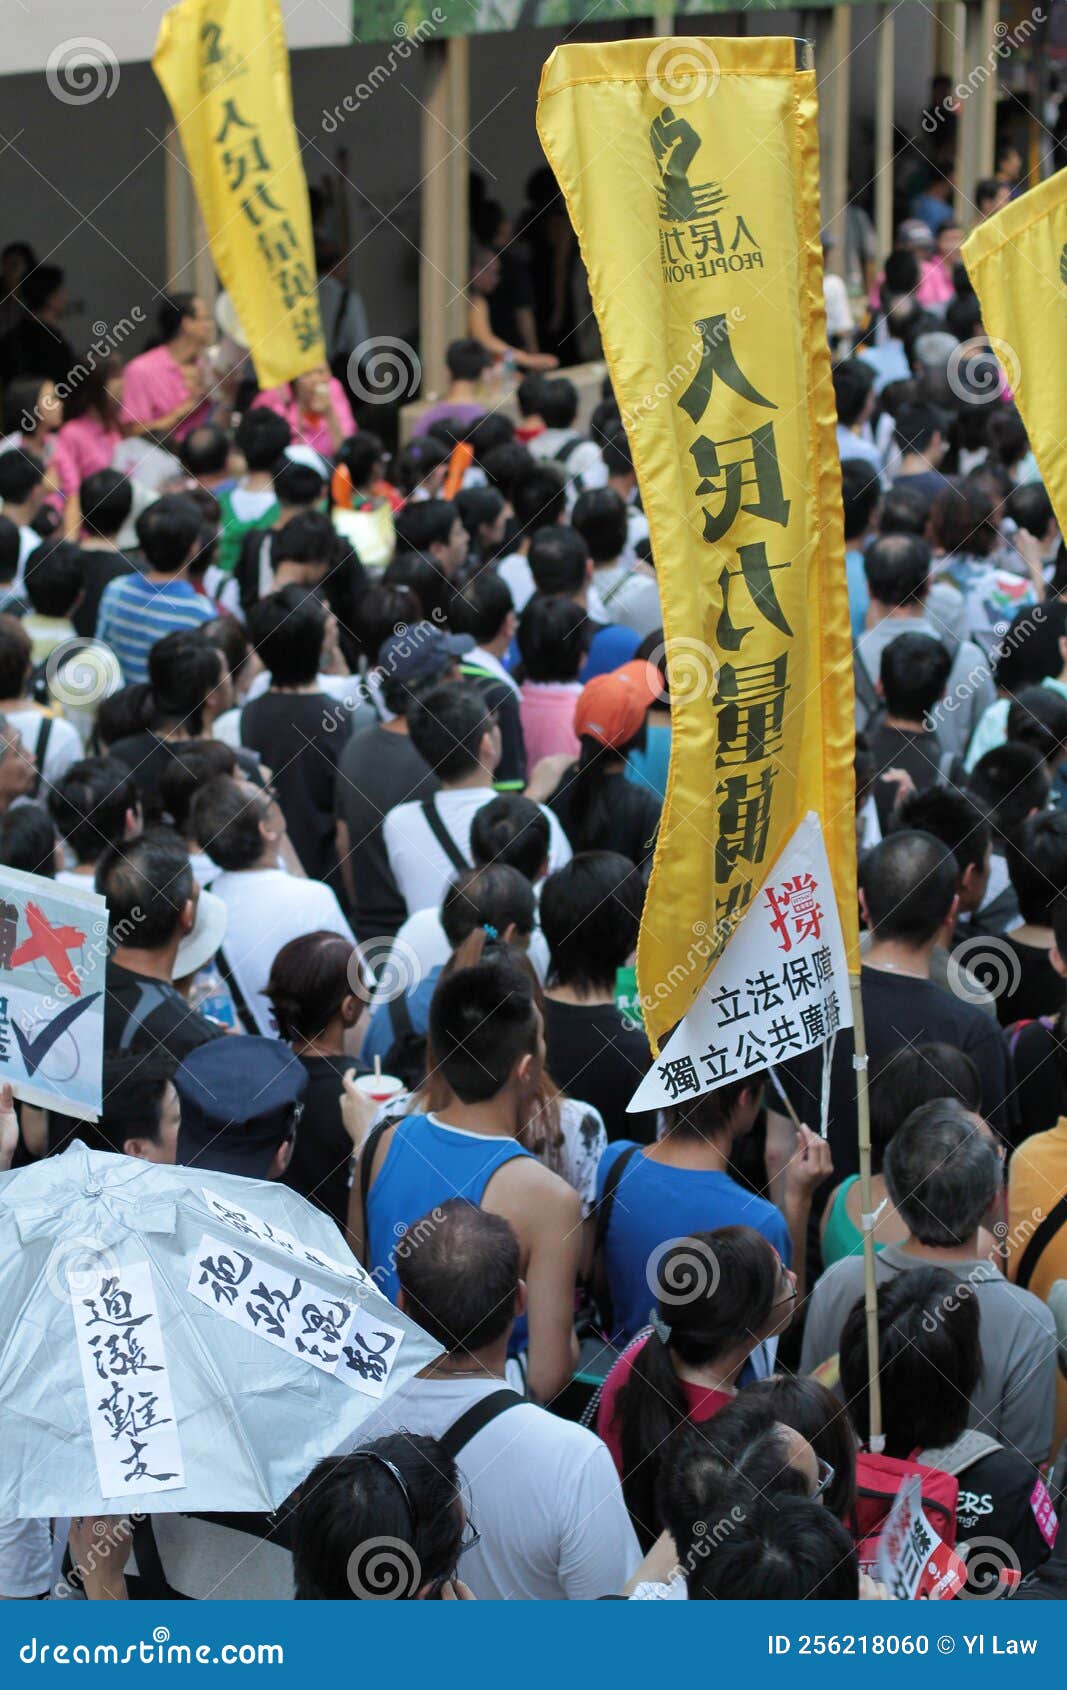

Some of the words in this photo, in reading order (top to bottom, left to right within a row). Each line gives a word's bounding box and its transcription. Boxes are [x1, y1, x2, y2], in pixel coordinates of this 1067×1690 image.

[711, 944, 835, 1028] 立法保障
[656, 990, 841, 1100] 獨立公共廣播
